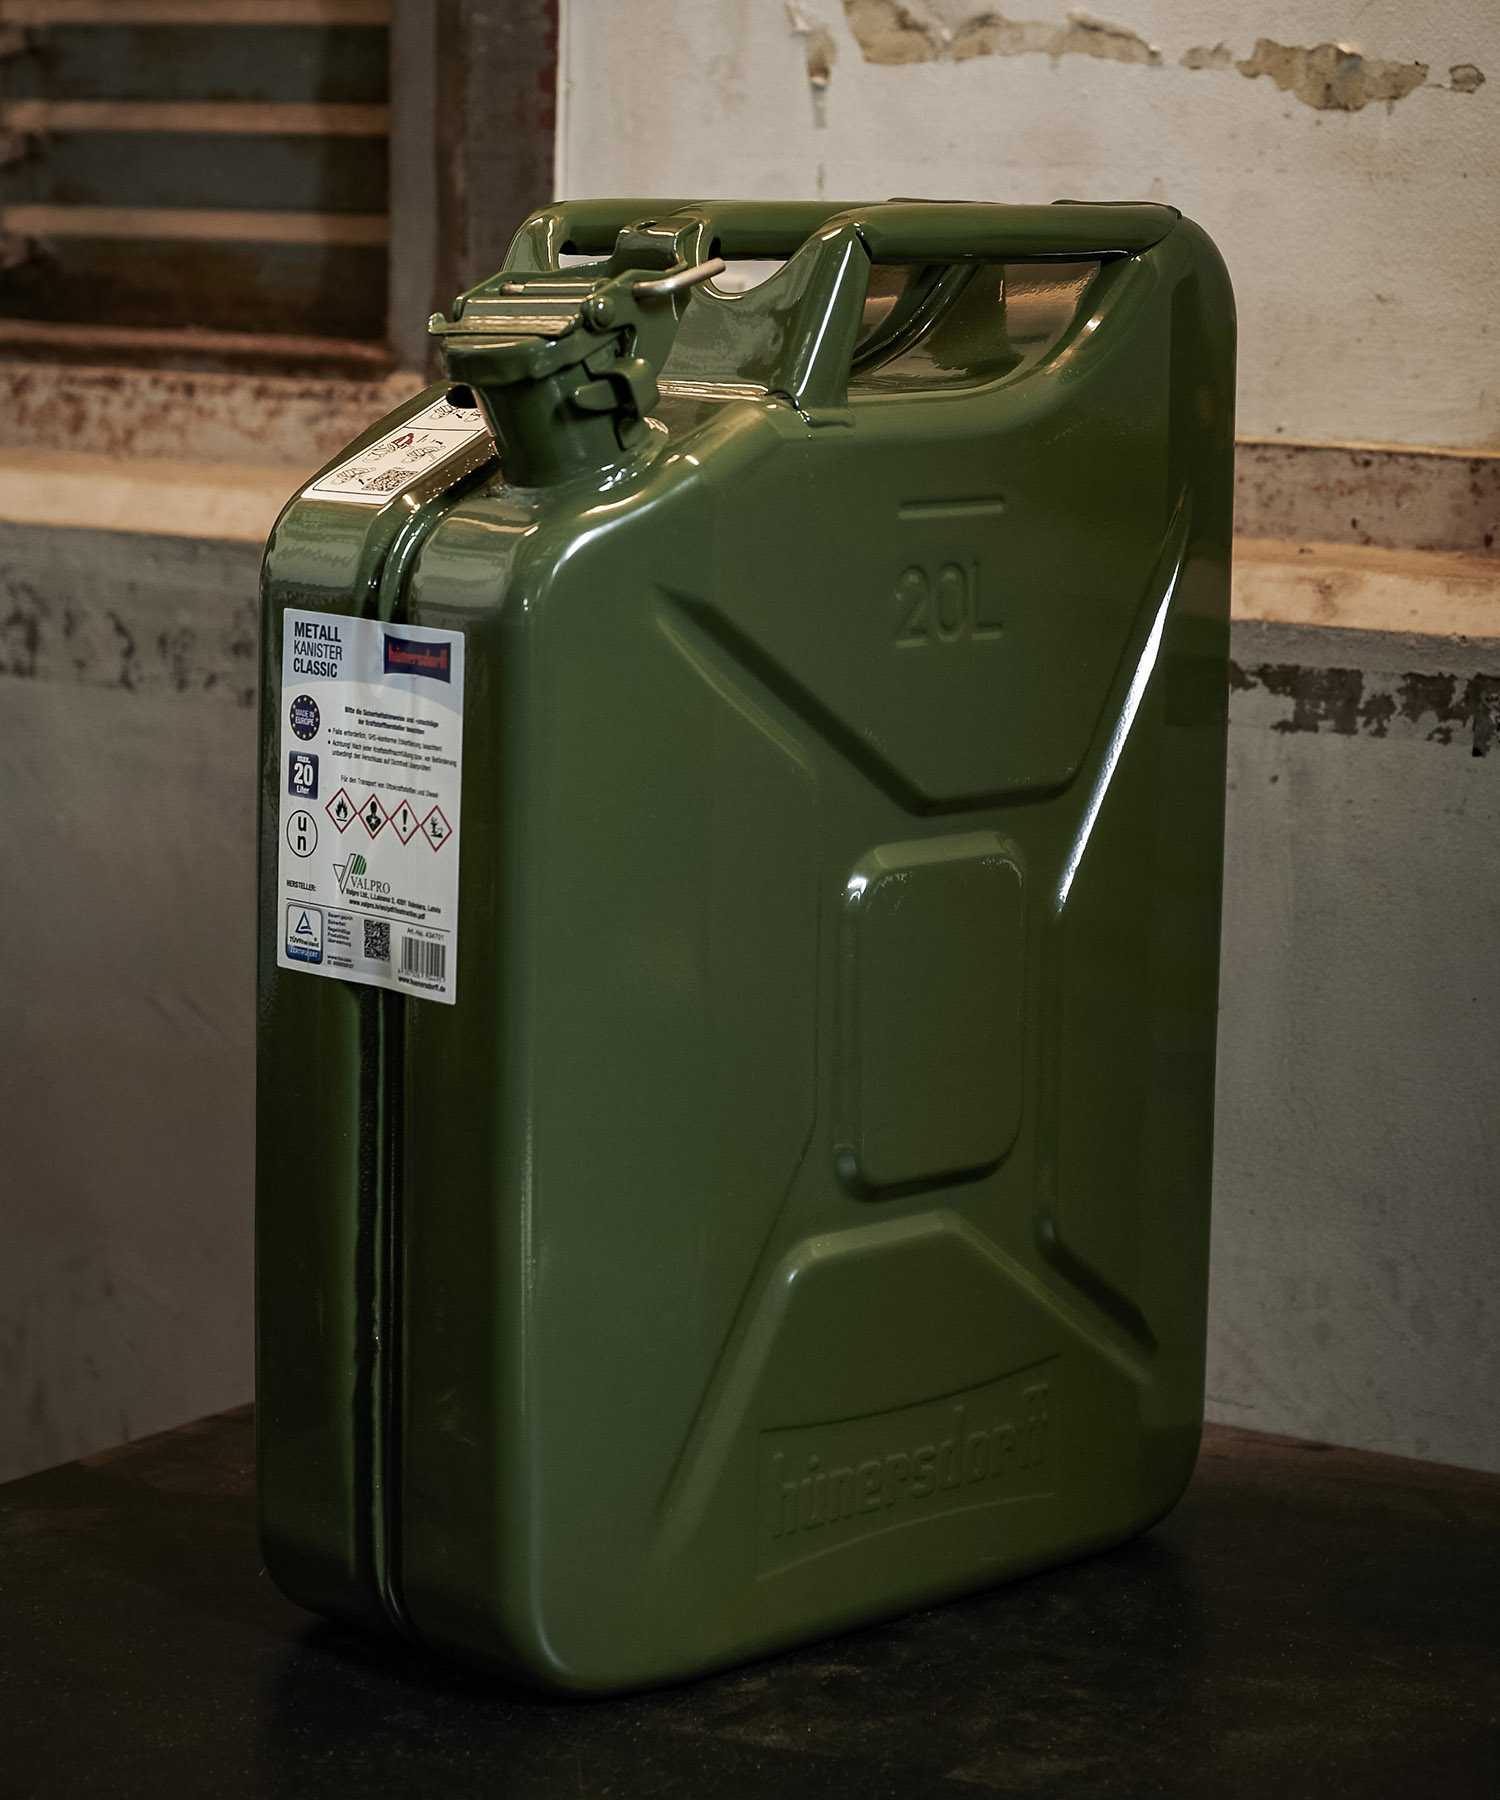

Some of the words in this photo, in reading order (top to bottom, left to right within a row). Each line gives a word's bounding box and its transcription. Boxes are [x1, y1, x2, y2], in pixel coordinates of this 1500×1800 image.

[895, 559, 1003, 648] 20L
[294, 621, 342, 643] METALL
[294, 640, 343, 661] KANISTER
[293, 658, 338, 678] CLASSIC
[295, 708, 309, 718] MADE
[295, 716, 315, 727] EUROPE
[294, 762, 314, 786] 20
[296, 784, 310, 795] Liter
[351, 876, 391, 894] VALPRO
